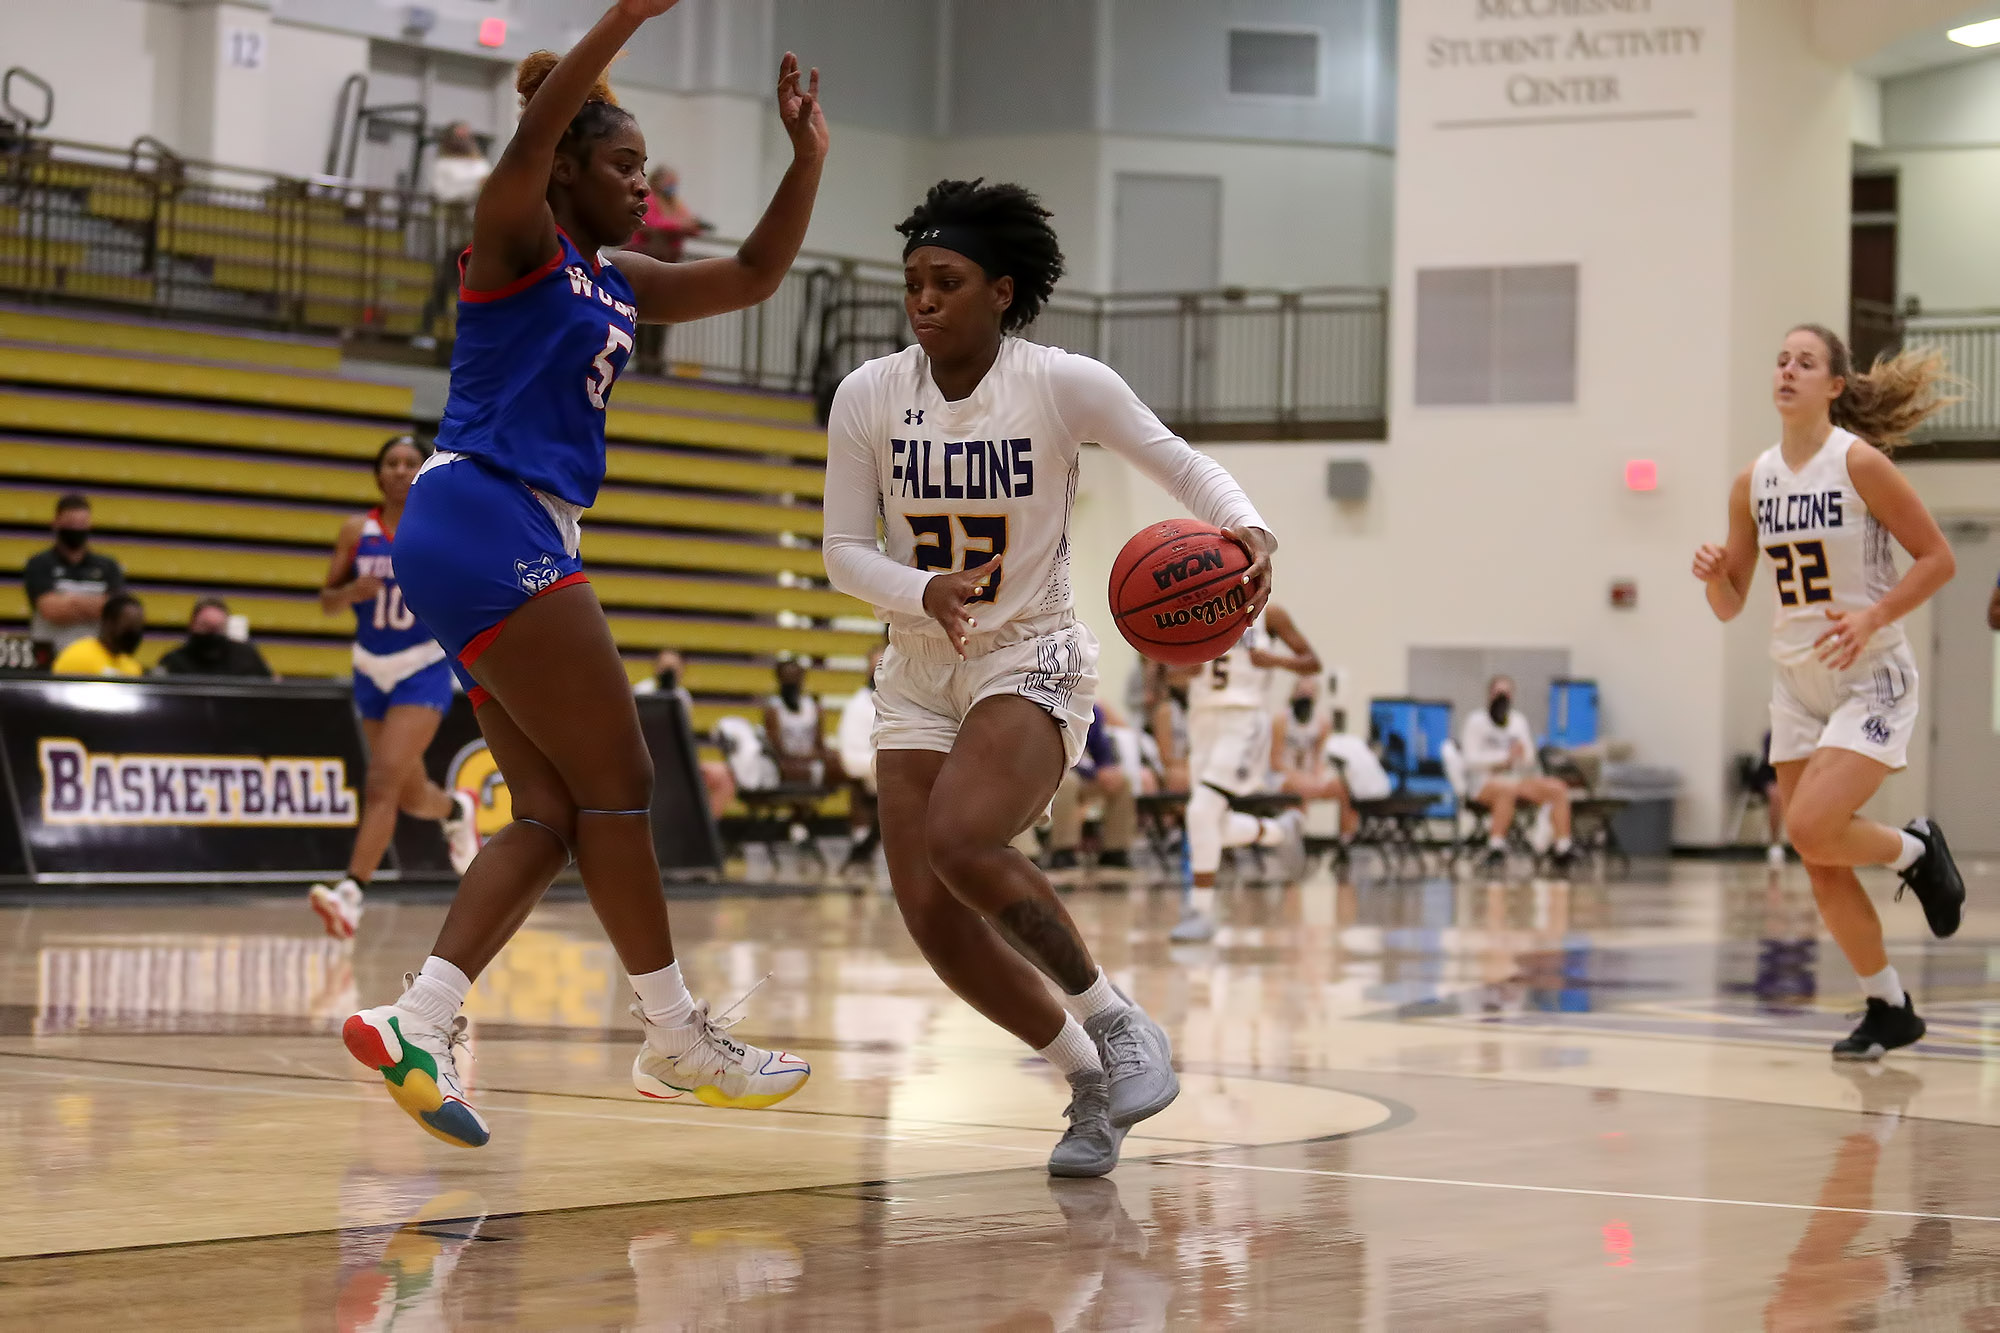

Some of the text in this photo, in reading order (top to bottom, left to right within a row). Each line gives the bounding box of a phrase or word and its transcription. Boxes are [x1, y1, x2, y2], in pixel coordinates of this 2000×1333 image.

[232, 31, 260, 68] 12
[1426, 26, 1705, 68] STUDENT ACTIVITY
[1506, 73, 1620, 106] CENTER
[585, 322, 634, 410] 5
[890, 438, 1034, 499] FALCONS
[1757, 491, 1843, 535] FALCONS
[1152, 548, 1224, 591] NCAA
[1764, 538, 1834, 607] 22
[373, 584, 416, 631] 10
[1153, 583, 1247, 629] Wilson
[1212, 655, 1230, 691] 5
[41, 741, 355, 823] BASKETBALL
